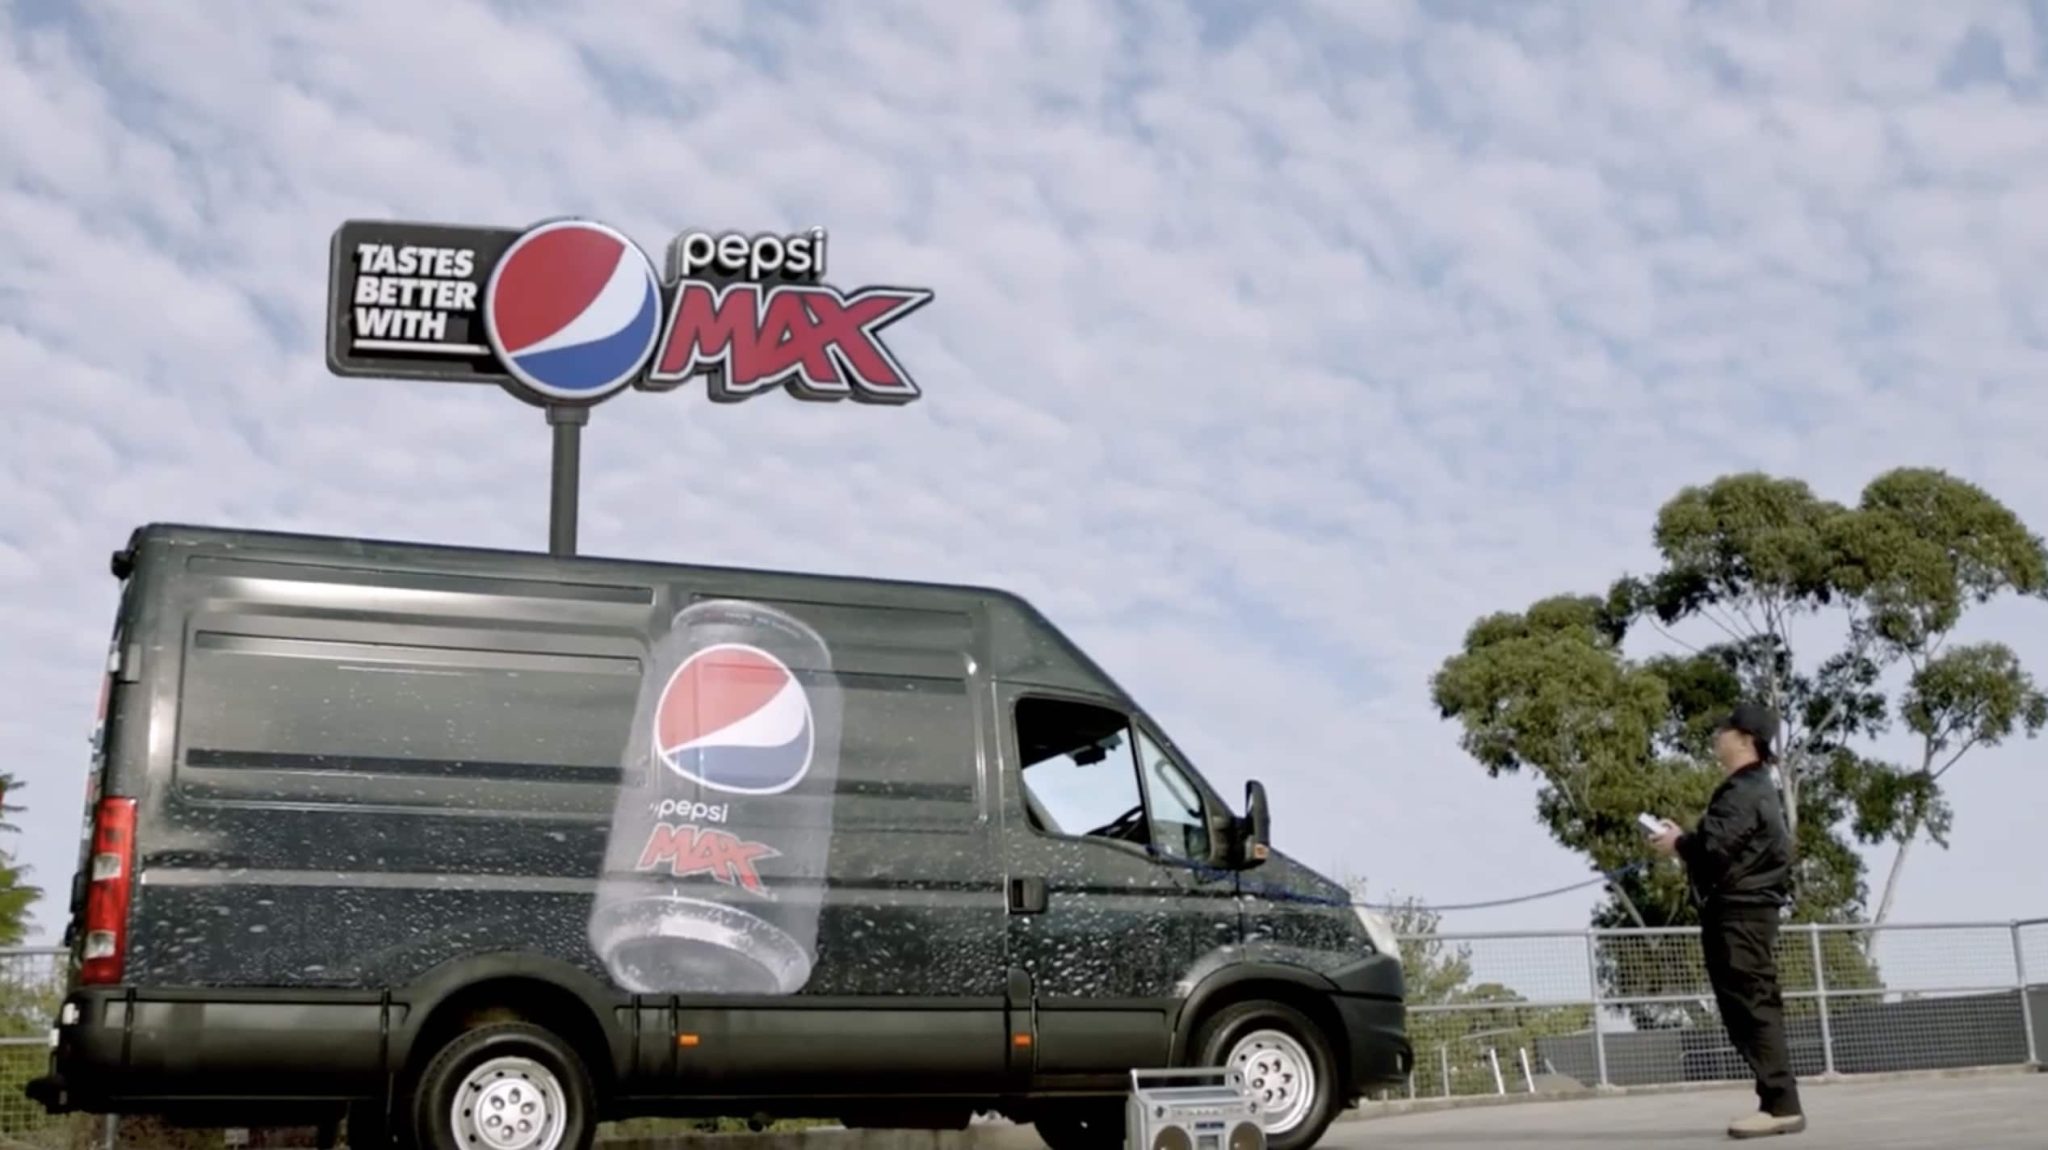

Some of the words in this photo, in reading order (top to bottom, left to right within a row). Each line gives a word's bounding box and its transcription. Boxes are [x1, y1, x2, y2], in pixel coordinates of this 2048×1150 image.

[357, 244, 475, 275] TASTES
[682, 227, 825, 280] pepsi
[356, 276, 477, 310] BETTER
[355, 308, 447, 340] WITH
[650, 282, 933, 394] MAX
[658, 799, 729, 822] pepsi
[637, 824, 782, 897] MAX
